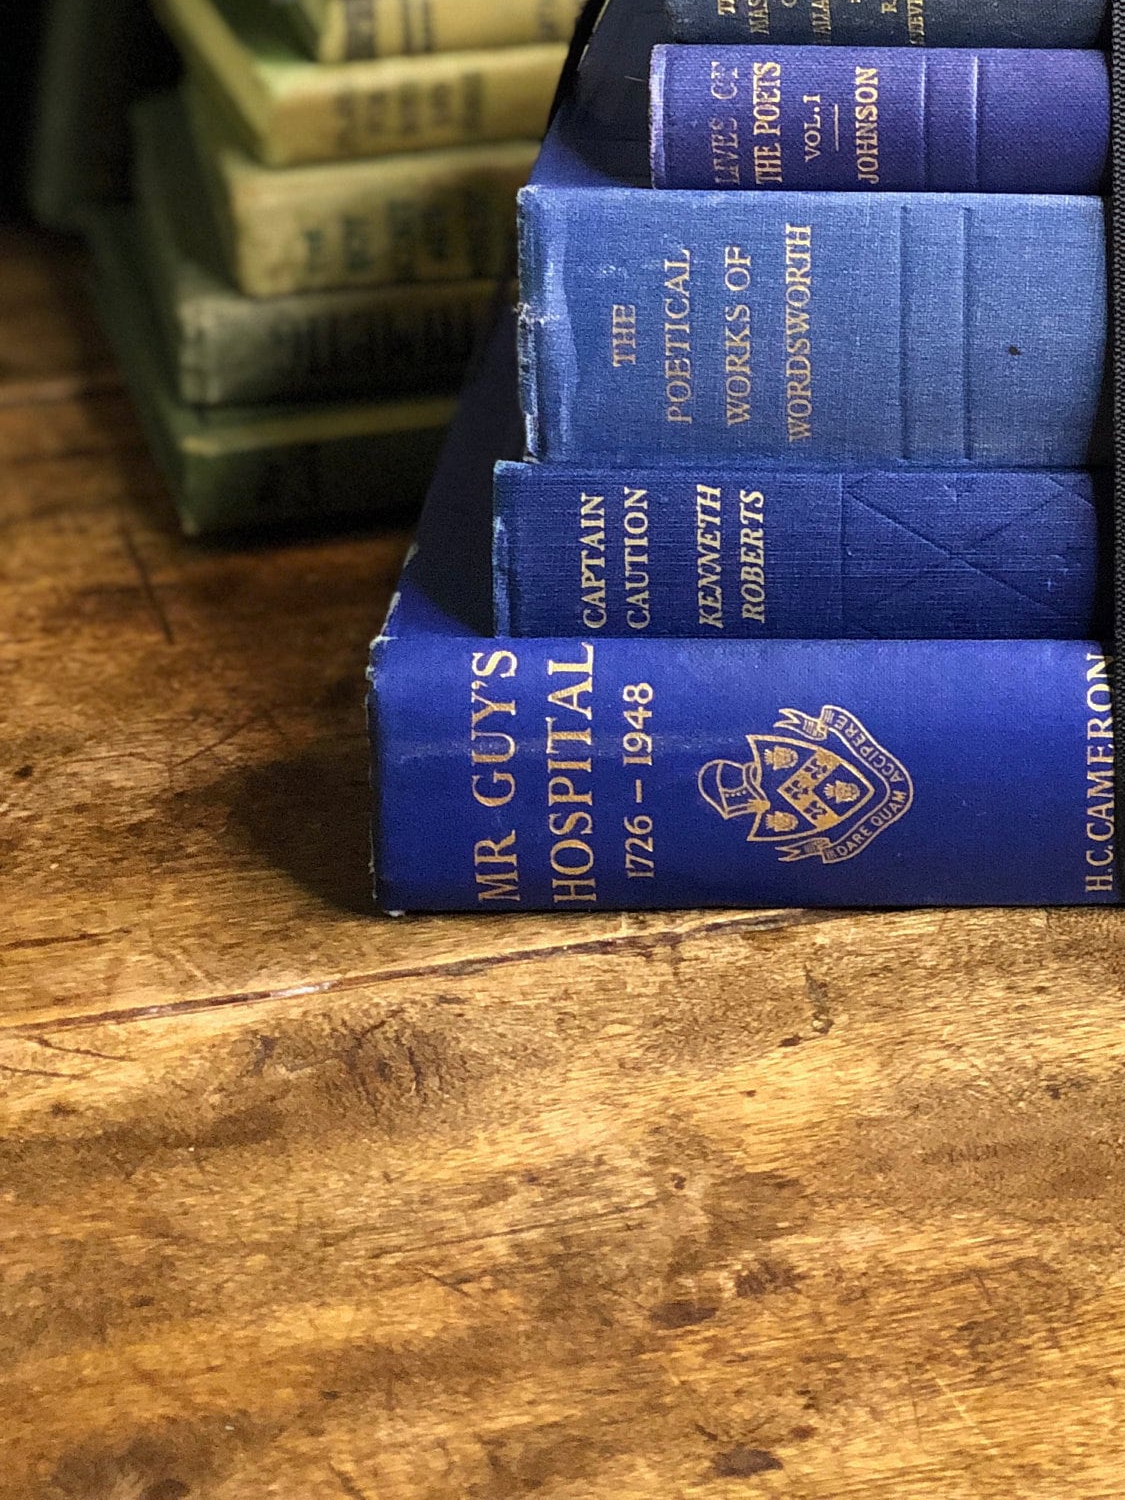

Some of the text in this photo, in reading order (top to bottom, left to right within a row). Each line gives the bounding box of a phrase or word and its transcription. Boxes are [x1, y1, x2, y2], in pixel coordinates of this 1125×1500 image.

[709, 116, 740, 185] LIVES
[752, 61, 783, 184] THE POETS
[855, 65, 880, 184] JOHNSON
[612, 304, 636, 367] THE
[664, 249, 692, 425] POETICAL
[725, 246, 754, 426] WORKS OF
[785, 223, 813, 443] WORDSWORTH
[580, 492, 606, 629] CAPTAIN
[624, 486, 650, 630] CAUTION
[696, 484, 724, 629] KENNETH
[739, 489, 766, 624] ROBERTS
[471, 648, 522, 902] MR GUY'S
[545, 641, 597, 903] HOSPITAL
[621, 680, 653, 766] 1948
[833, 713, 906, 857] DARE QUAM ACCIPERE
[625, 814, 655, 879] 1726
